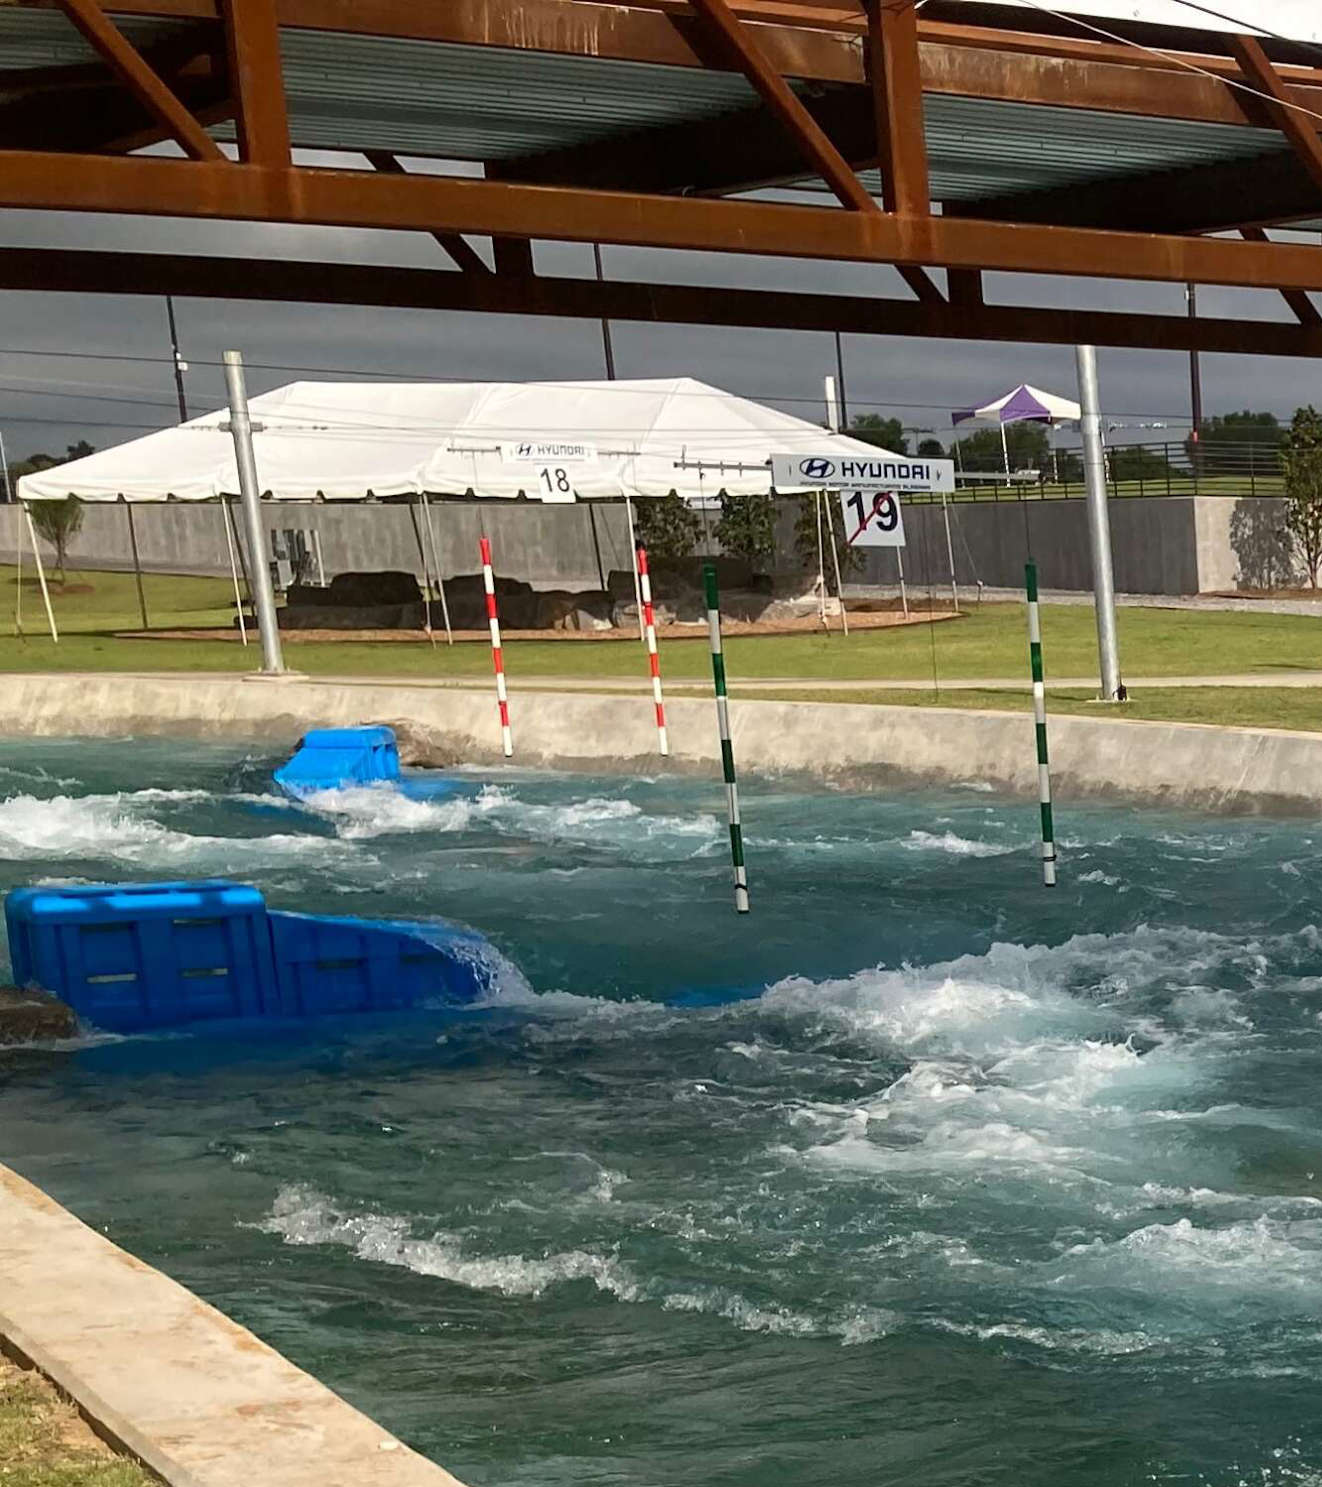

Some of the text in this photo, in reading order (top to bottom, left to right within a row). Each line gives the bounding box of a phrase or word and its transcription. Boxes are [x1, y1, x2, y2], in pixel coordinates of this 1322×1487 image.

[537, 444, 585, 456] HYUNDAI
[540, 467, 570, 493] 18
[841, 461, 930, 481] HYUNDAI
[847, 491, 898, 532] 19
